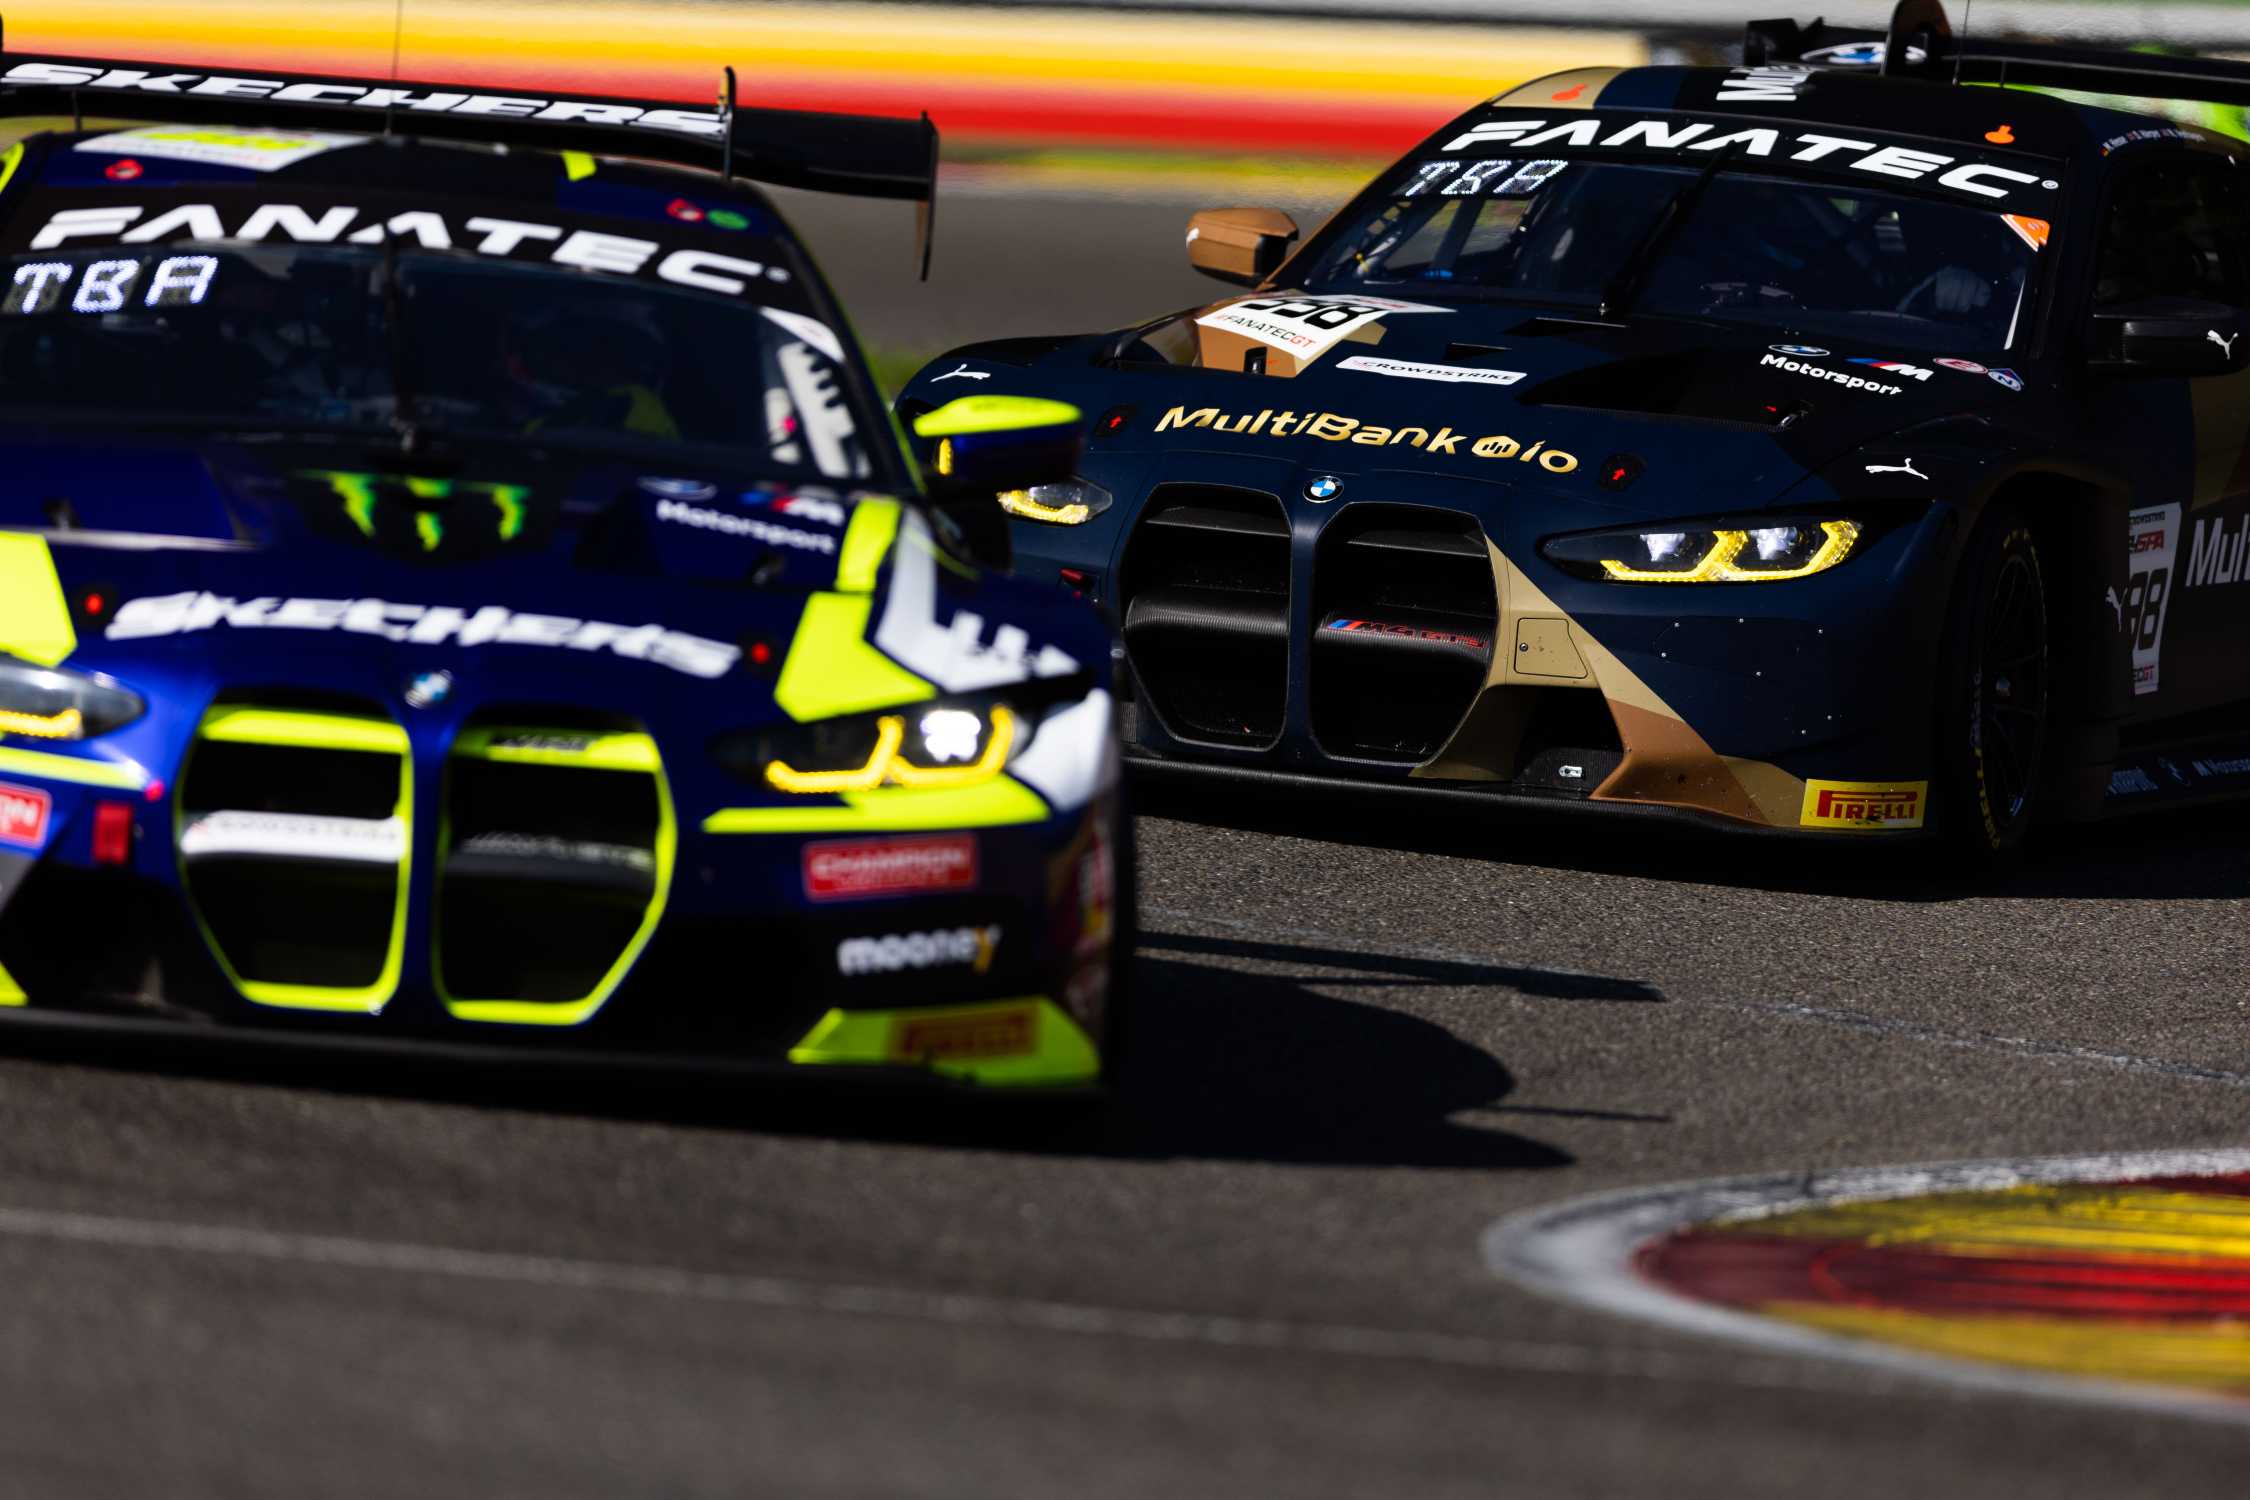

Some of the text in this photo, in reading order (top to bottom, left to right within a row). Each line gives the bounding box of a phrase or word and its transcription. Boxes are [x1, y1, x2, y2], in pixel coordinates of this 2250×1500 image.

[2, 62, 731, 134] SKECHERS
[10, 255, 219, 314] TBA
[1361, 361, 1513, 381] CROWDSTRIKE
[1760, 353, 1902, 395] Motorsport
[1155, 405, 1468, 456] MultiBank
[656, 498, 836, 556] Motorsport
[105, 590, 743, 679] SKECHERS
[1815, 789, 1918, 820] PIRELLI
[836, 922, 1001, 976] mooney
